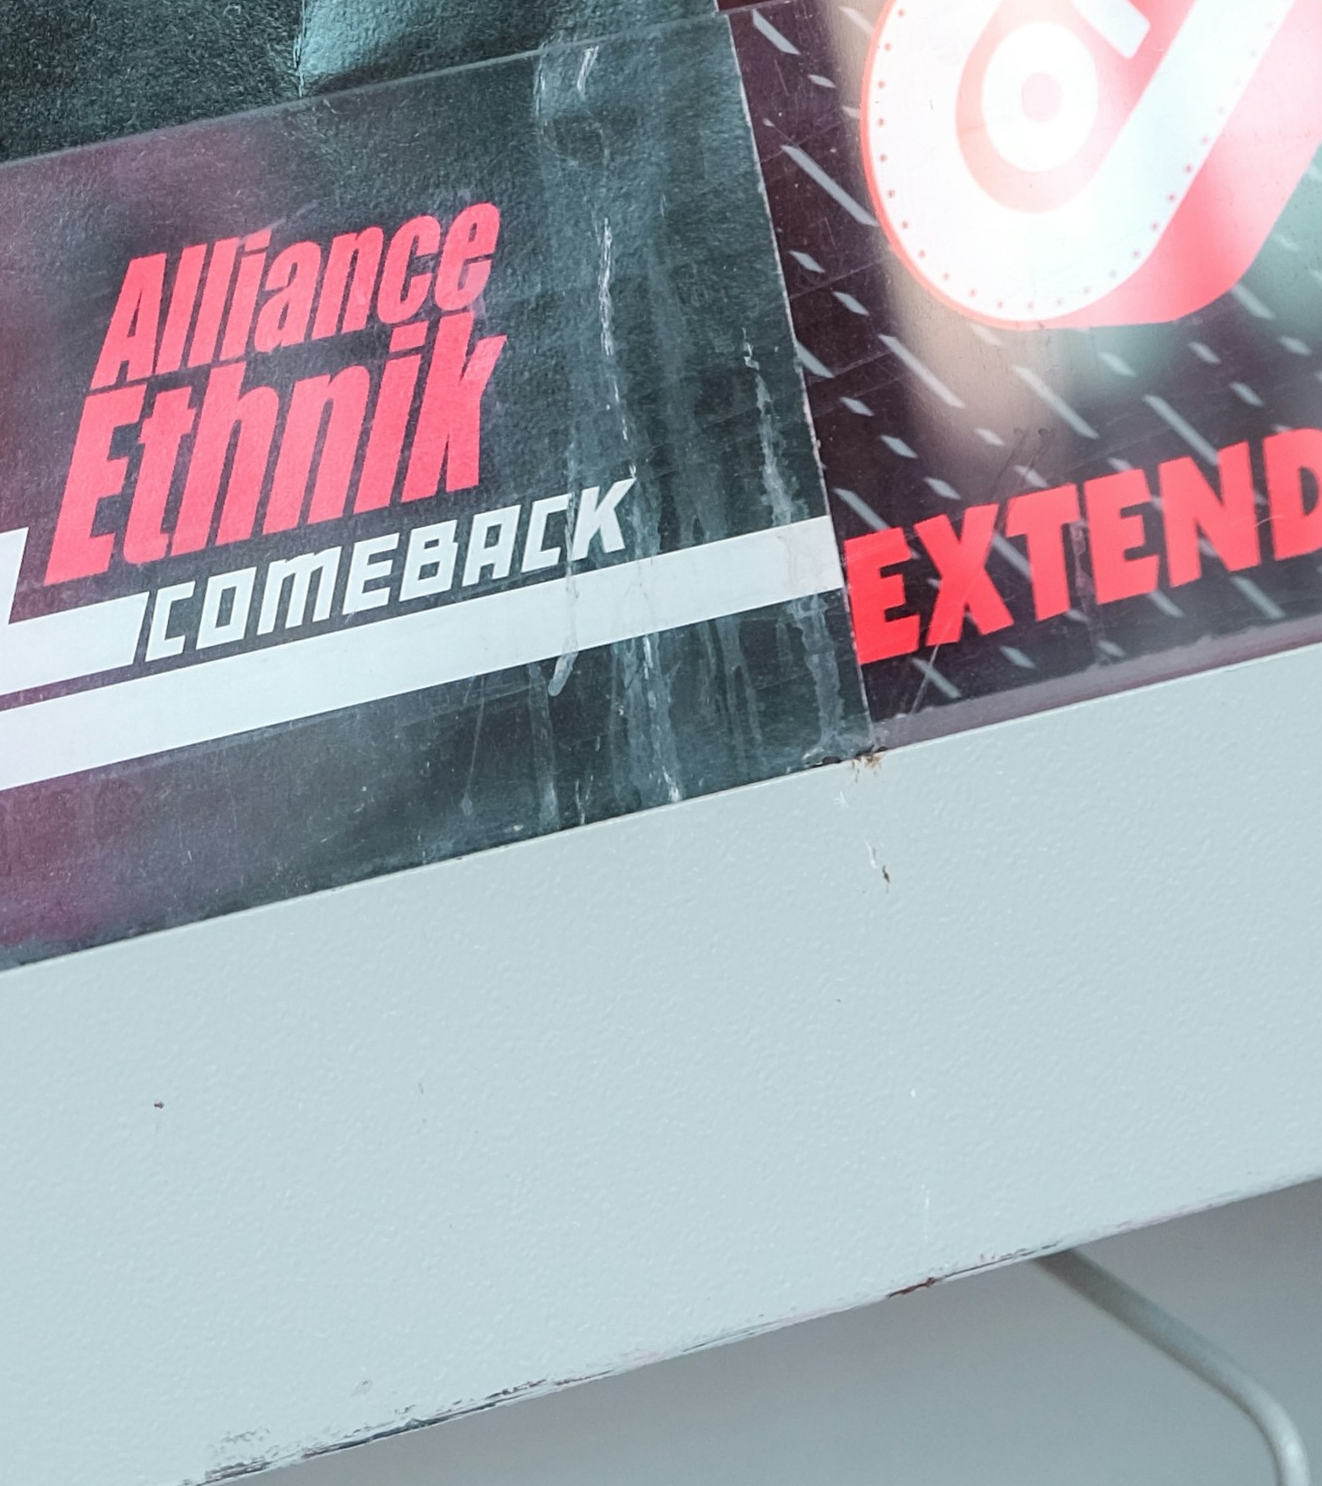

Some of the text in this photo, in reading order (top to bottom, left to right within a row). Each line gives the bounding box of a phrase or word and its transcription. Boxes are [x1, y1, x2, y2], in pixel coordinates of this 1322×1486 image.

[89, 200, 502, 393] Alliance
[44, 312, 507, 588] Ethnik
[144, 477, 636, 663] COMEBACK
